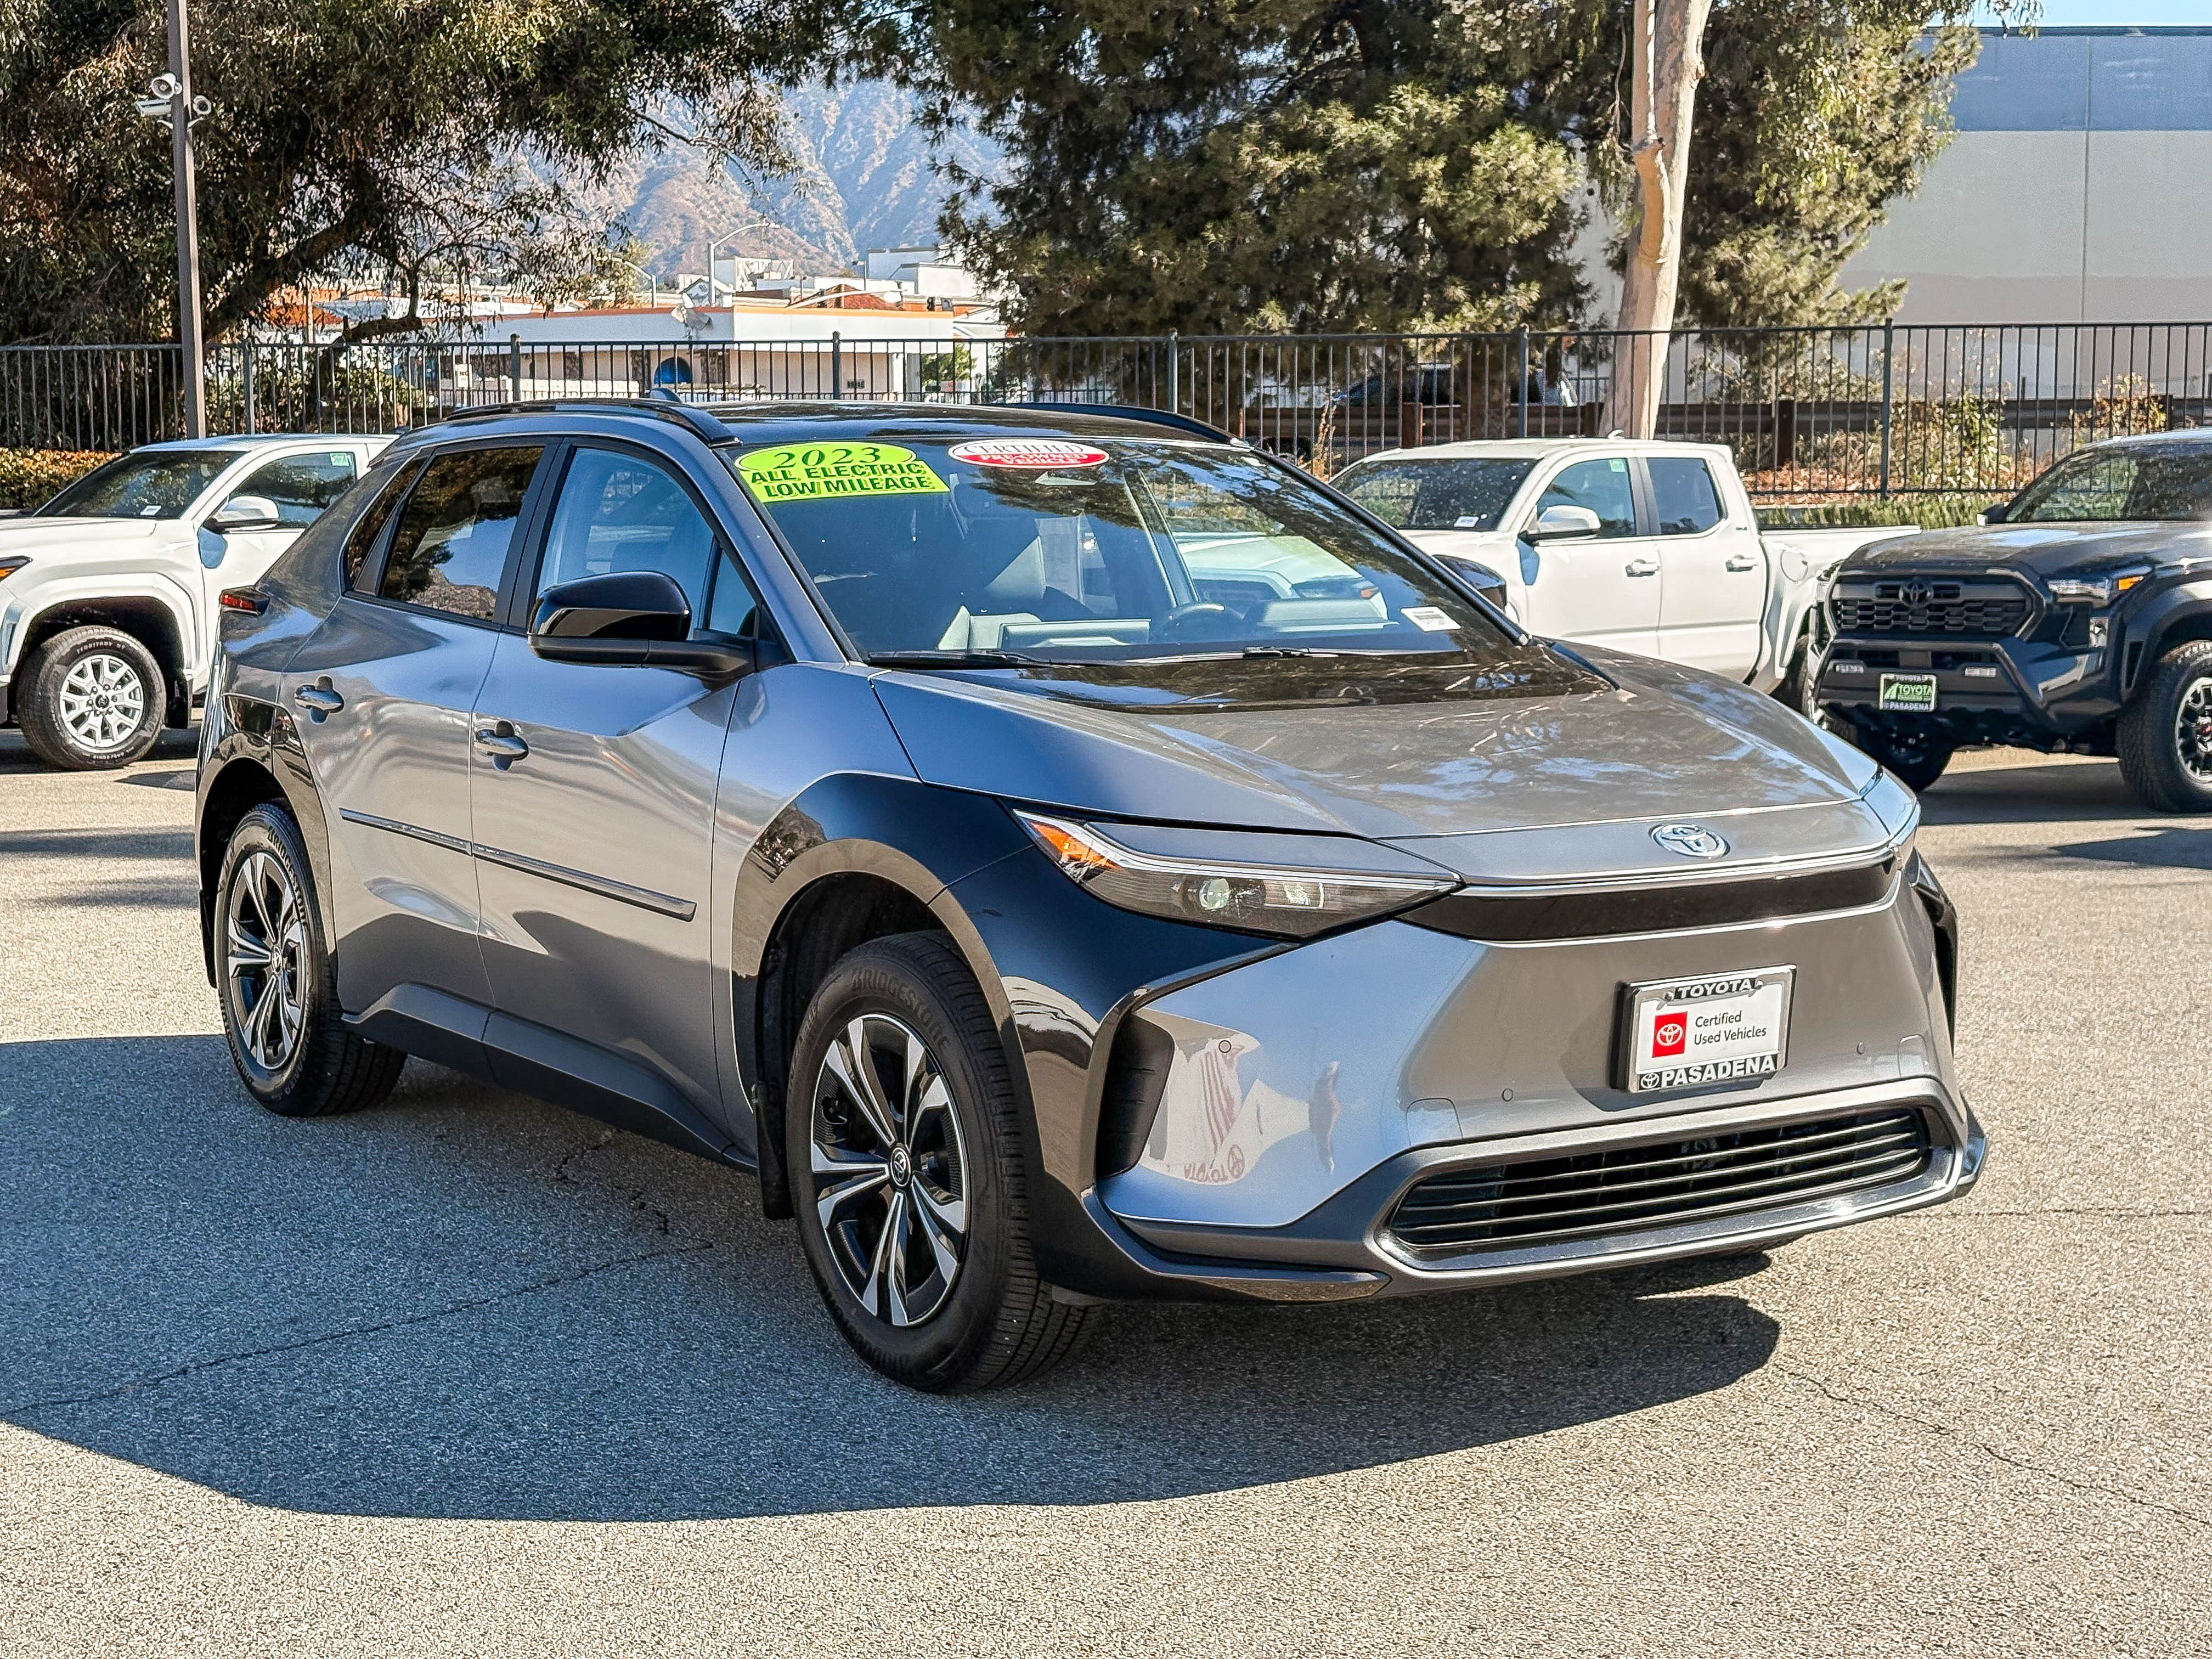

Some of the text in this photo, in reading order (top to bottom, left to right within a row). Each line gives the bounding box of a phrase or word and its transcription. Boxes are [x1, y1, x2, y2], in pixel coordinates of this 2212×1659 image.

[773, 447, 880, 469] 2023
[964, 444, 1084, 454] CERTIFIED
[751, 462, 923, 483] ALL ELECTRIC
[764, 476, 930, 497] LOW MILEAGE
[1898, 684, 1932, 695] TOYOTA
[1890, 702, 1929, 711] PASADENA
[1677, 978, 1752, 998] TOYOTA
[1695, 1010, 1742, 1028] Certified
[1694, 1025, 1767, 1045] Used Vehicles
[1661, 1054, 1775, 1087] PASADENA
